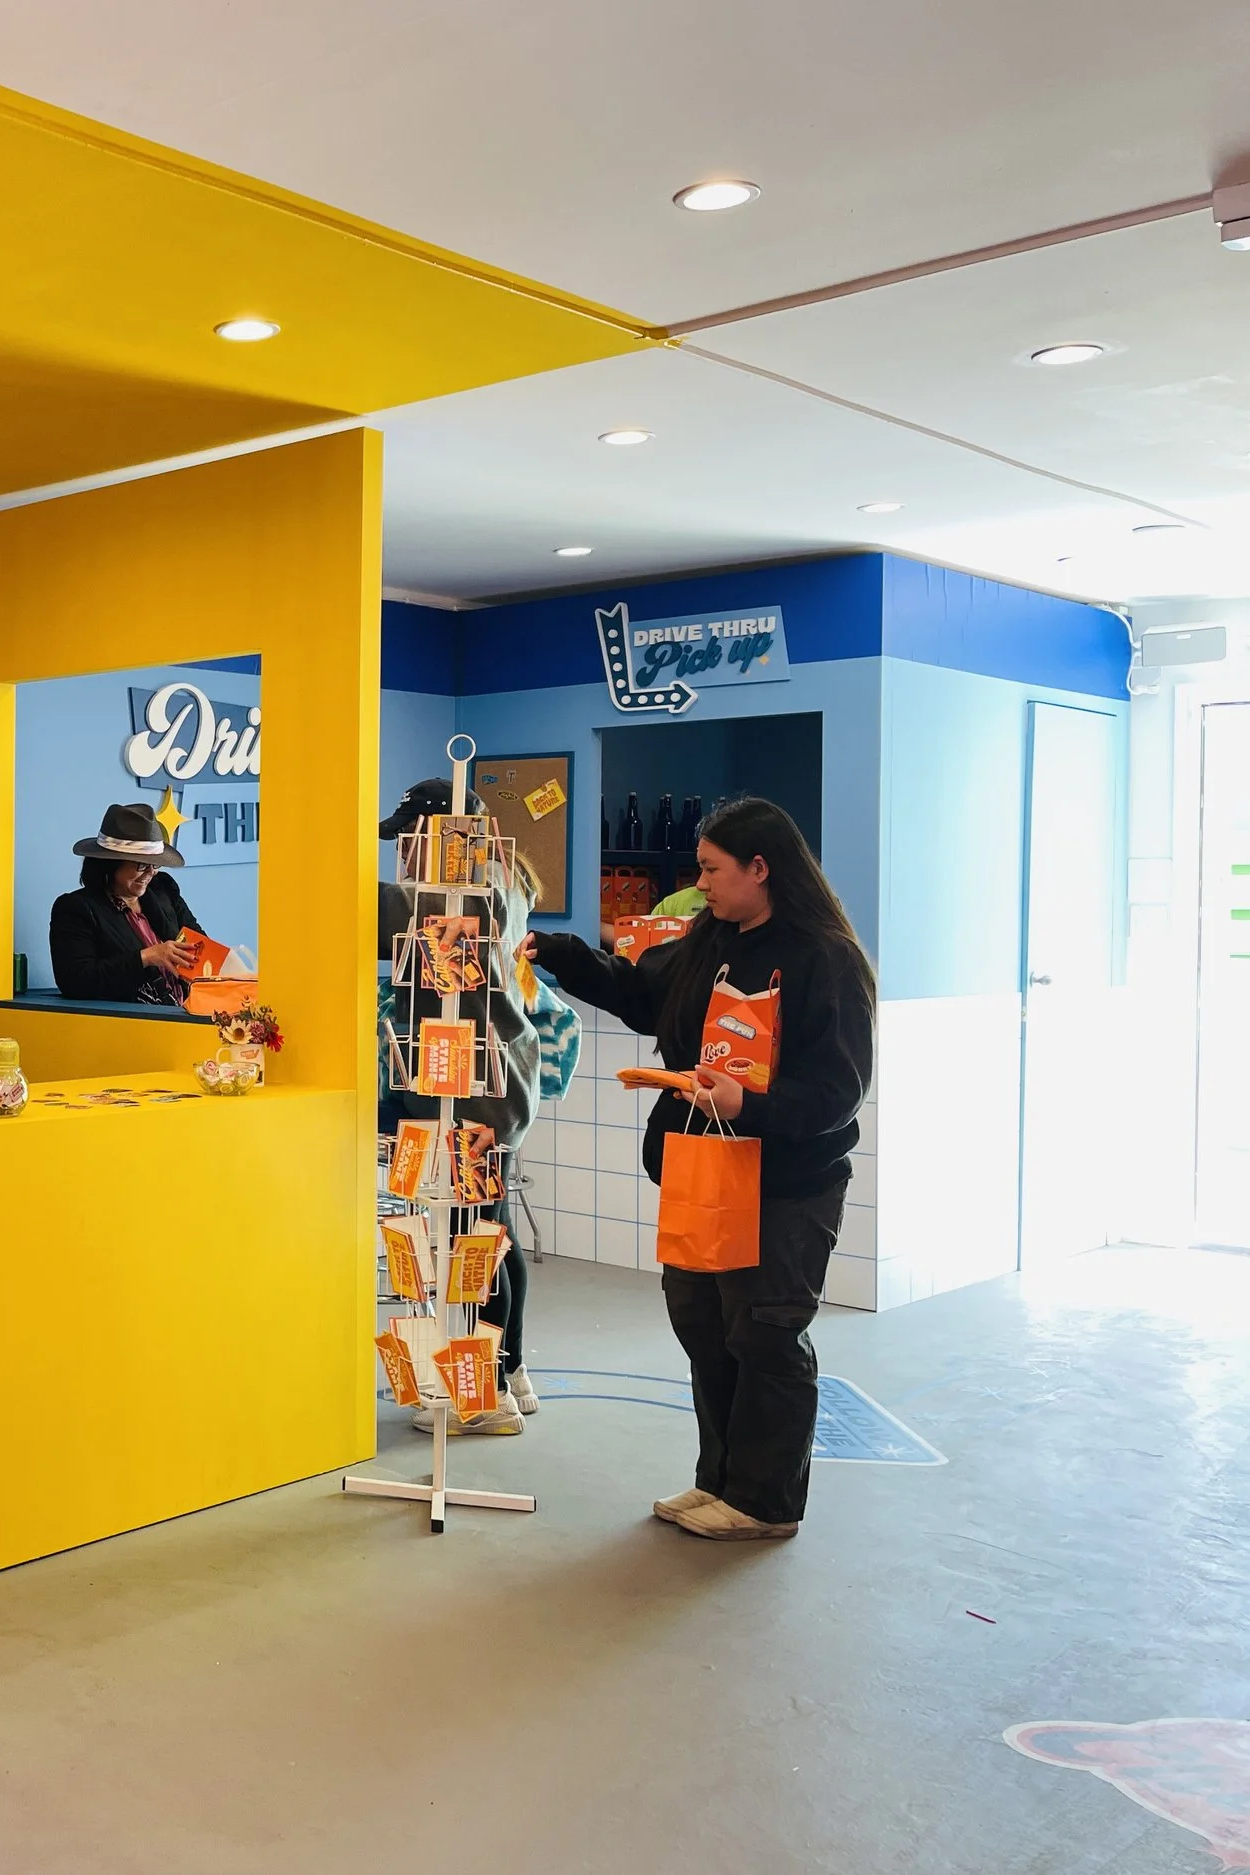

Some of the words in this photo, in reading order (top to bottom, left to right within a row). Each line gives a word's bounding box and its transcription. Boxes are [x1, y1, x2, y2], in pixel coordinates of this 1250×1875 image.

[634, 624, 703, 647] DRIVE
[708, 616, 776, 638] THRU
[636, 636, 722, 688] Pick
[728, 632, 774, 673] up
[125, 682, 261, 780] Dri
[194, 802, 260, 845] TH
[438, 1039, 449, 1083] STATE
[704, 1044, 726, 1063] Love
[466, 1247, 479, 1261] TO
[462, 1263, 473, 1292] BACK
[464, 1353, 476, 1399] STATE
